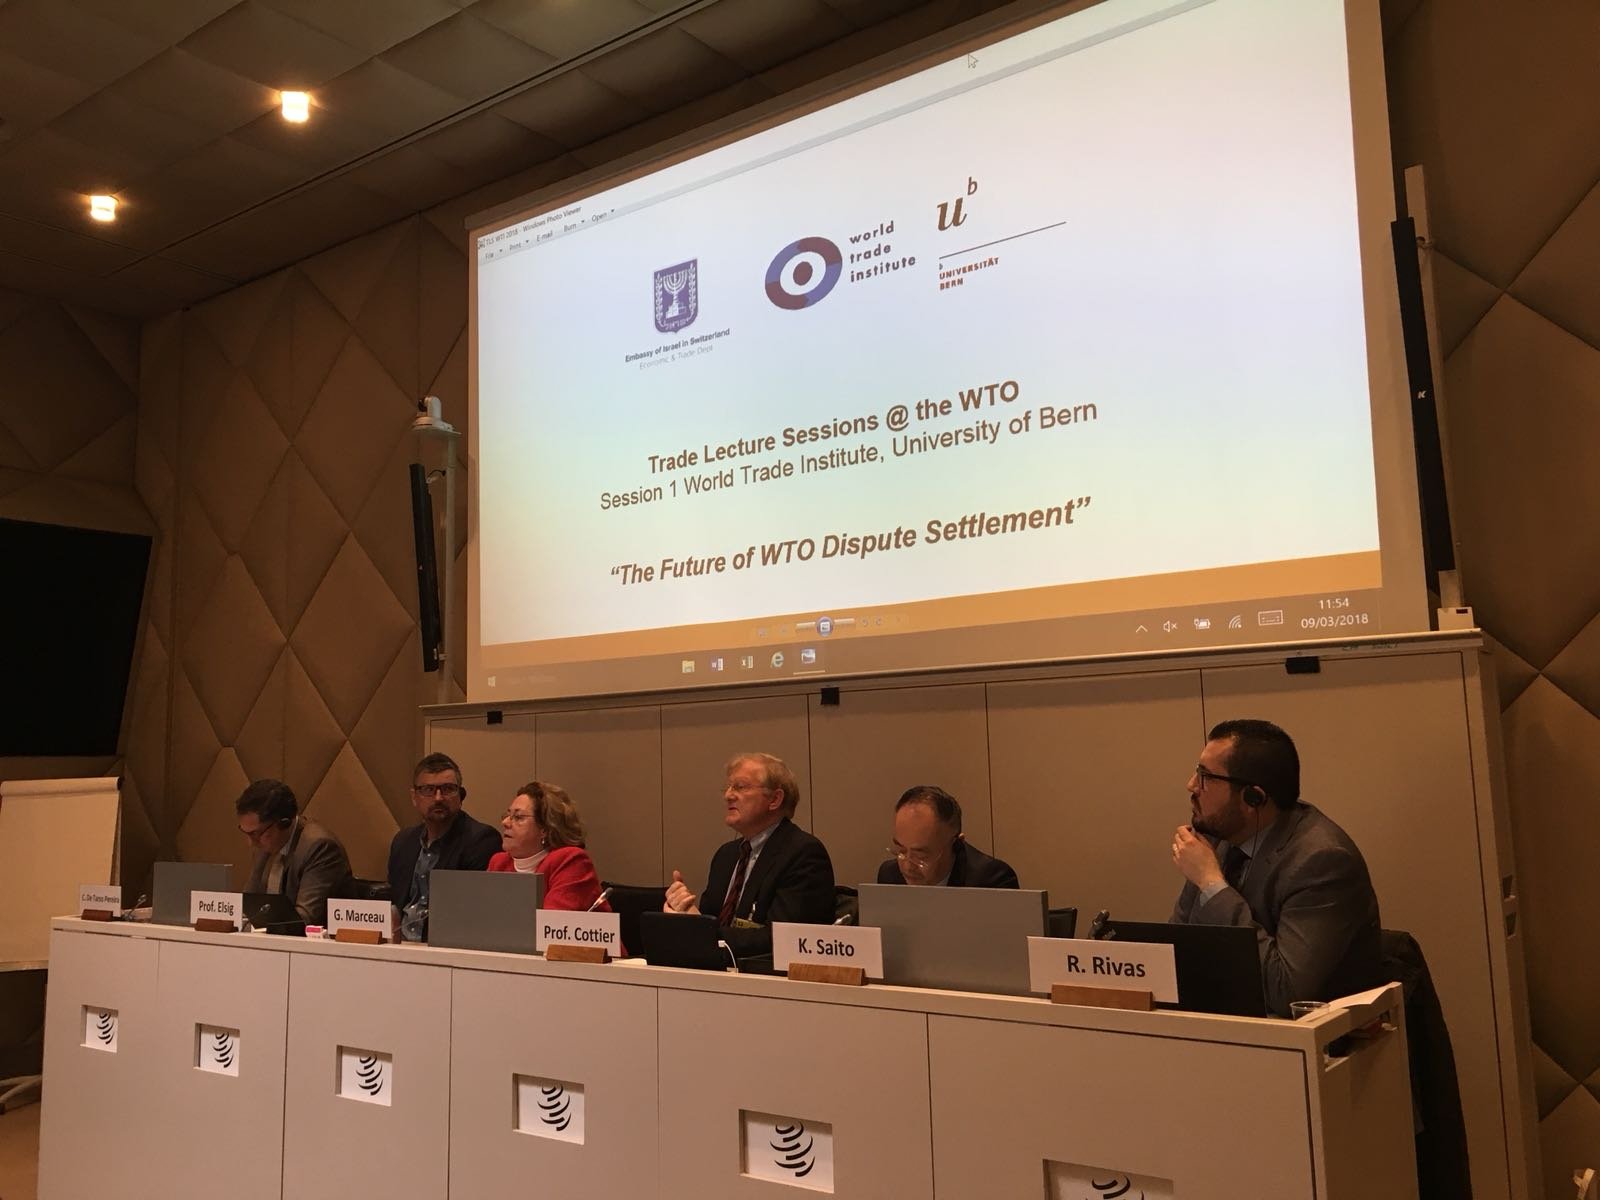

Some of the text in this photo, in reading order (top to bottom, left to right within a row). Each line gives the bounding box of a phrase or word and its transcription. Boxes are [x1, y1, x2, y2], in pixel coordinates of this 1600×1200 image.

[522, 221, 546, 232] Windows
[546, 214, 562, 224] Photo
[563, 207, 582, 218] Viewer
[536, 231, 552, 241] E-mail
[564, 223, 576, 232] Burn
[592, 212, 607, 222] Open
[849, 220, 894, 244] world
[850, 243, 891, 264] trade
[850, 257, 915, 282] institute
[939, 257, 999, 279] UNIVERSITÄT
[940, 278, 963, 290] BERN
[625, 350, 653, 362] Embassy
[663, 341, 681, 352] Israel
[690, 328, 730, 345] Switzerland
[648, 380, 1020, 475] Trade Lecture Sessions @ the WTO
[600, 401, 1097, 511] Session 1 World Trade Institute, University of Bern
[660, 552, 726, 582] Future
[732, 546, 755, 571] of
[760, 538, 815, 567] WTO
[821, 526, 917, 560] Dispute
[1319, 598, 1349, 609] 11:54
[1301, 613, 1369, 629] 09/03/2018
[199, 901, 234, 916] Prof. Elsig
[334, 908, 385, 923] G. Marceau
[544, 925, 615, 944] Prof. Cottier
[798, 938, 854, 958] K. Saito
[1067, 955, 1145, 978] R. Rivas
